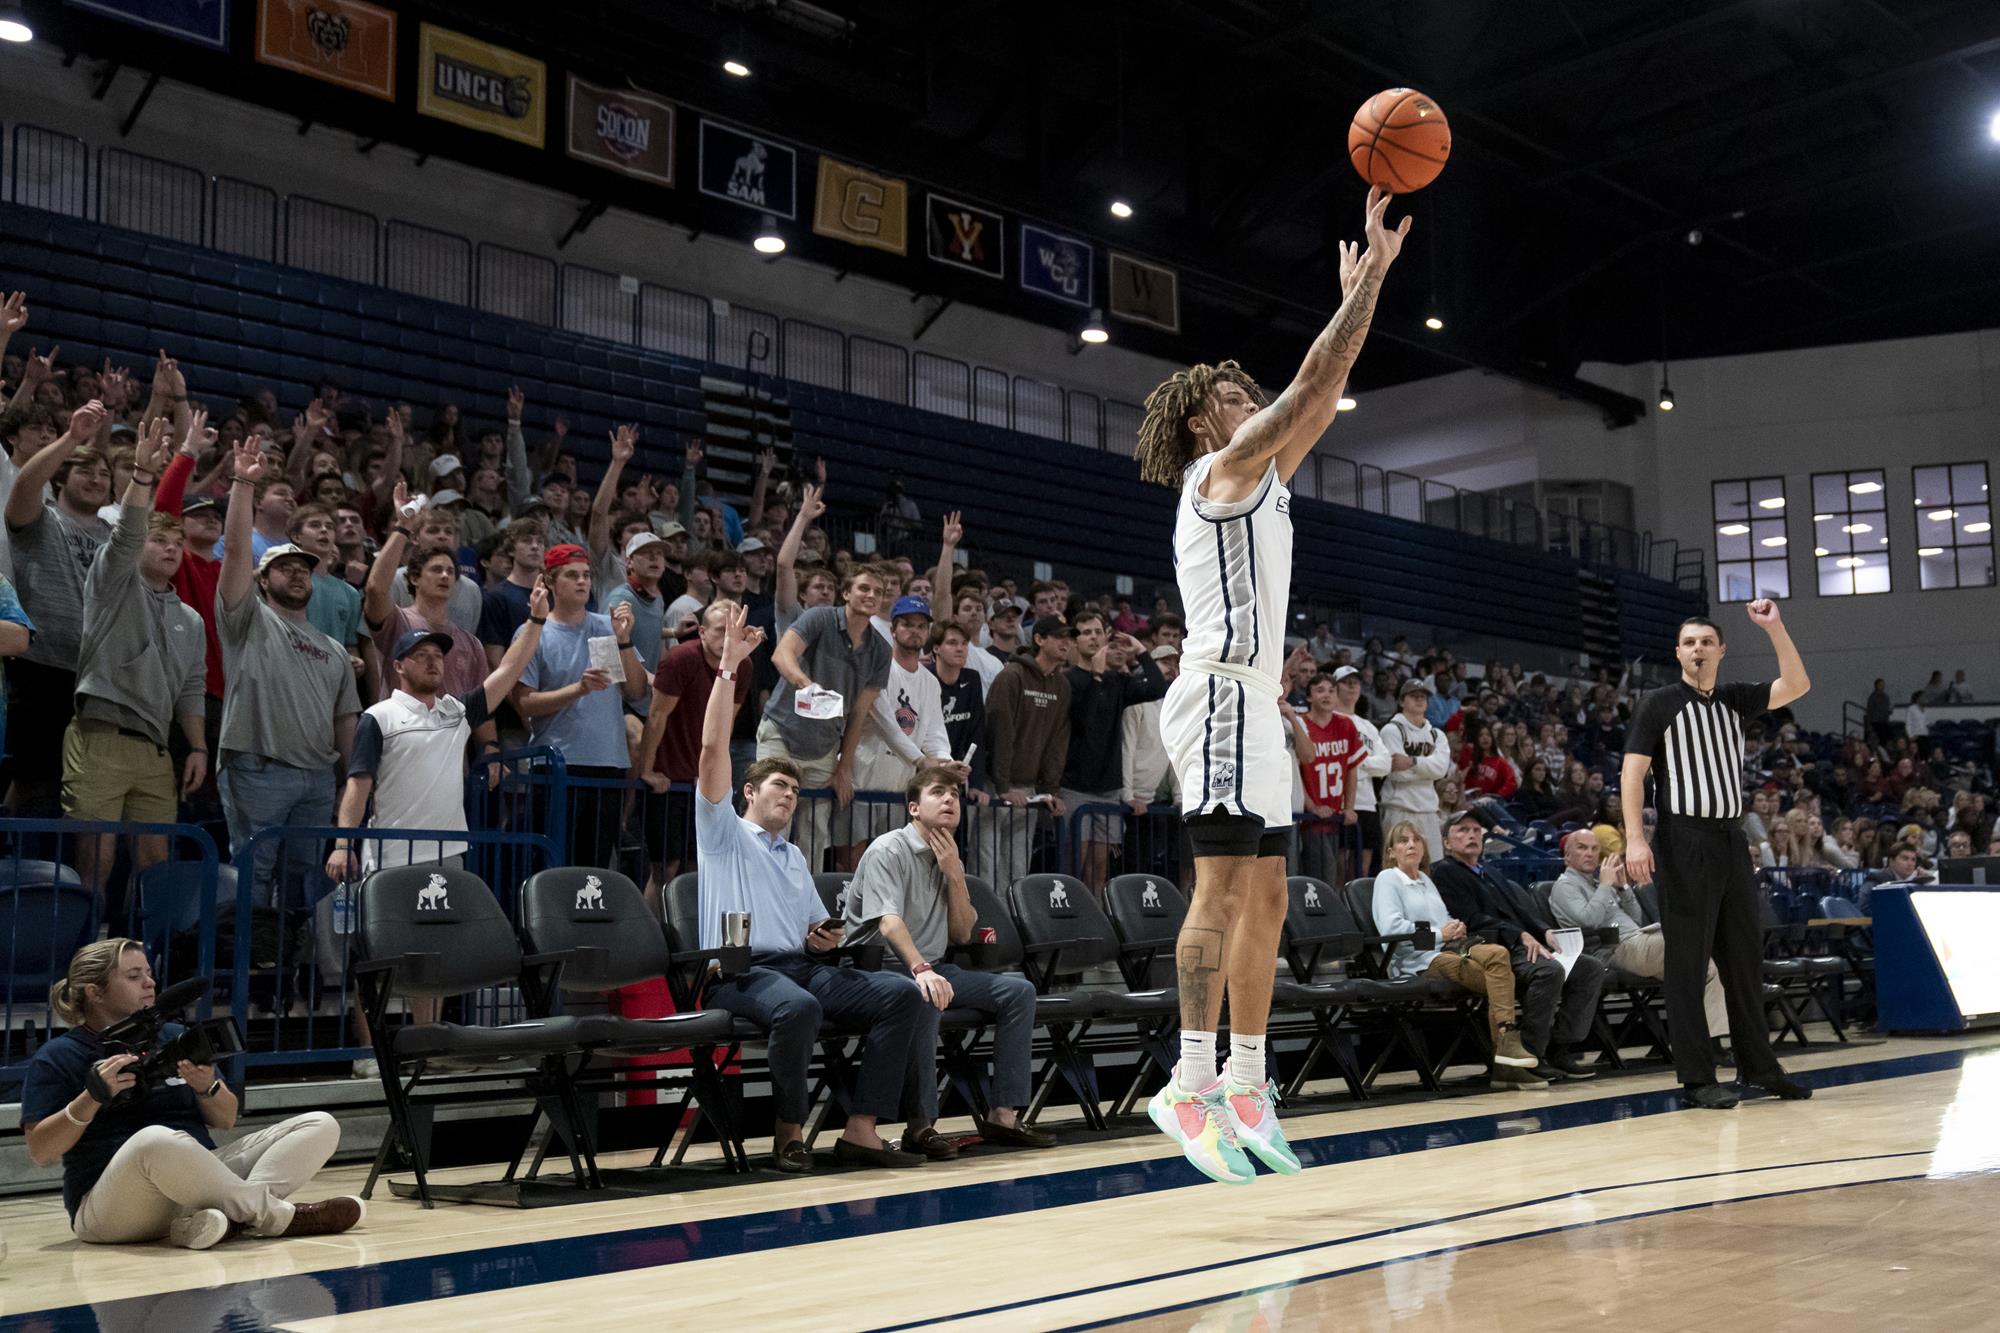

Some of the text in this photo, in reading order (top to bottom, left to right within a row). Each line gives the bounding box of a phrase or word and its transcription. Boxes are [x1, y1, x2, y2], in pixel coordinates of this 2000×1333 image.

[437, 61, 505, 106] UNCG
[597, 104, 651, 152] SOCON
[726, 180, 767, 206] SAM
[841, 178, 886, 235] C
[1130, 265, 1158, 302] W
[1315, 761, 1344, 799] 13
